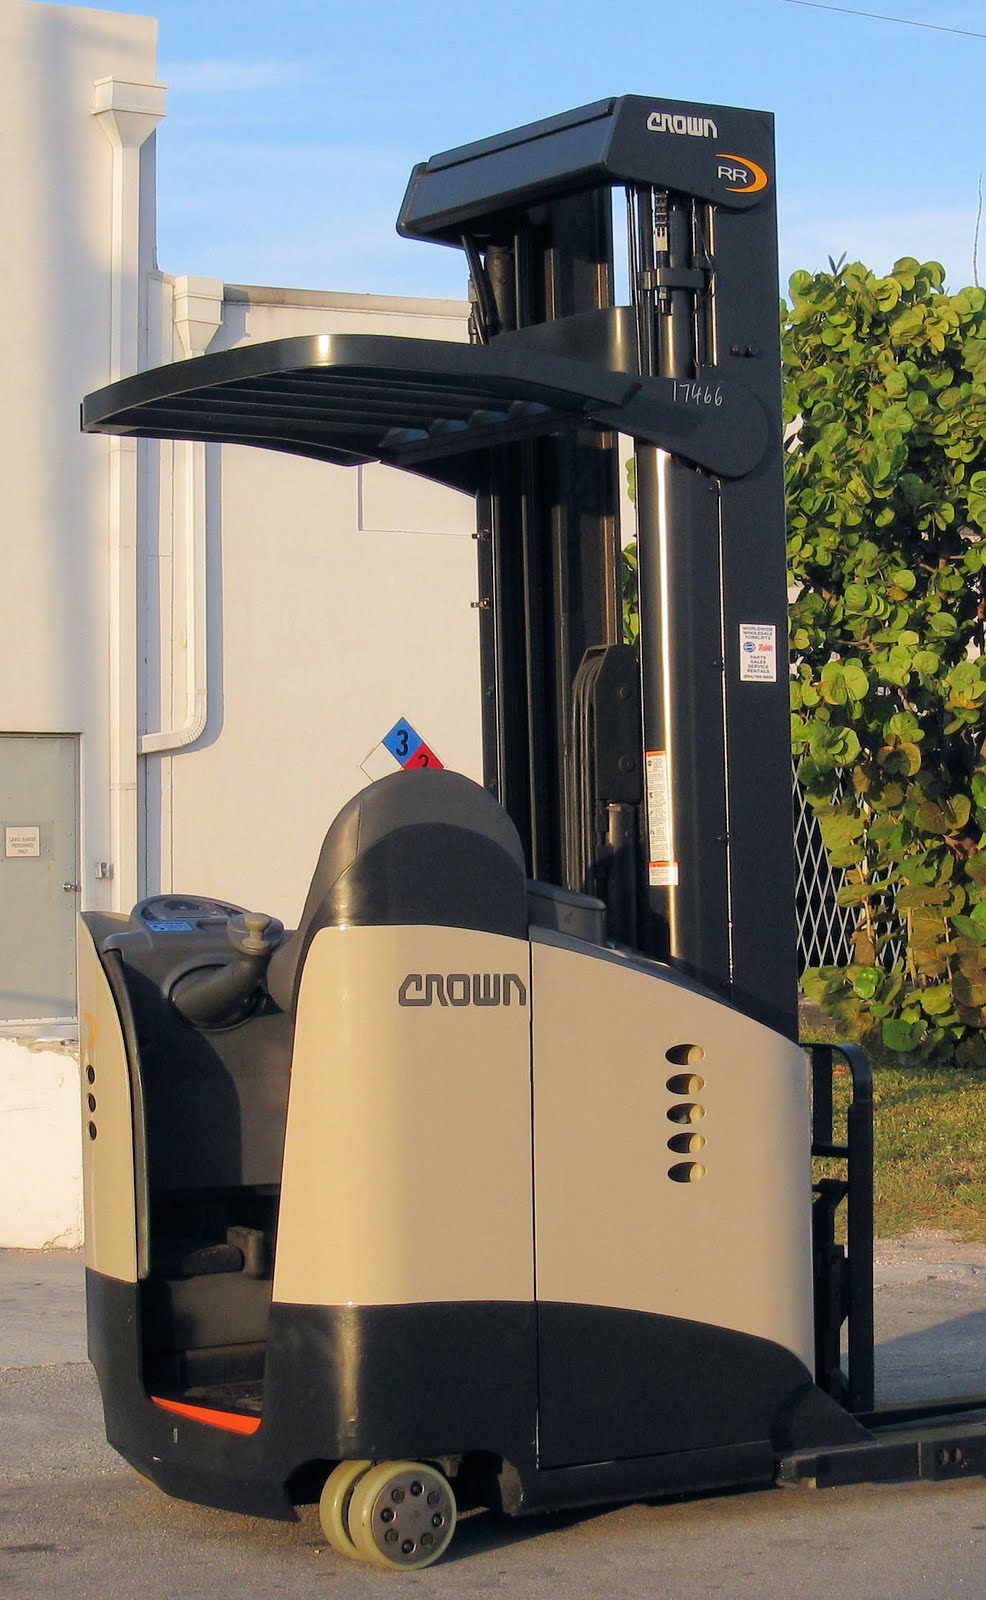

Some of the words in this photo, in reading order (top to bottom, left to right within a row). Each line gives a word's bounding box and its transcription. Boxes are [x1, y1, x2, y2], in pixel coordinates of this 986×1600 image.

[646, 112, 718, 139] CROWN
[717, 166, 748, 183] RR
[673, 380, 723, 406] 17466
[396, 730, 409, 756] 3
[399, 974, 526, 1006] CROWN
